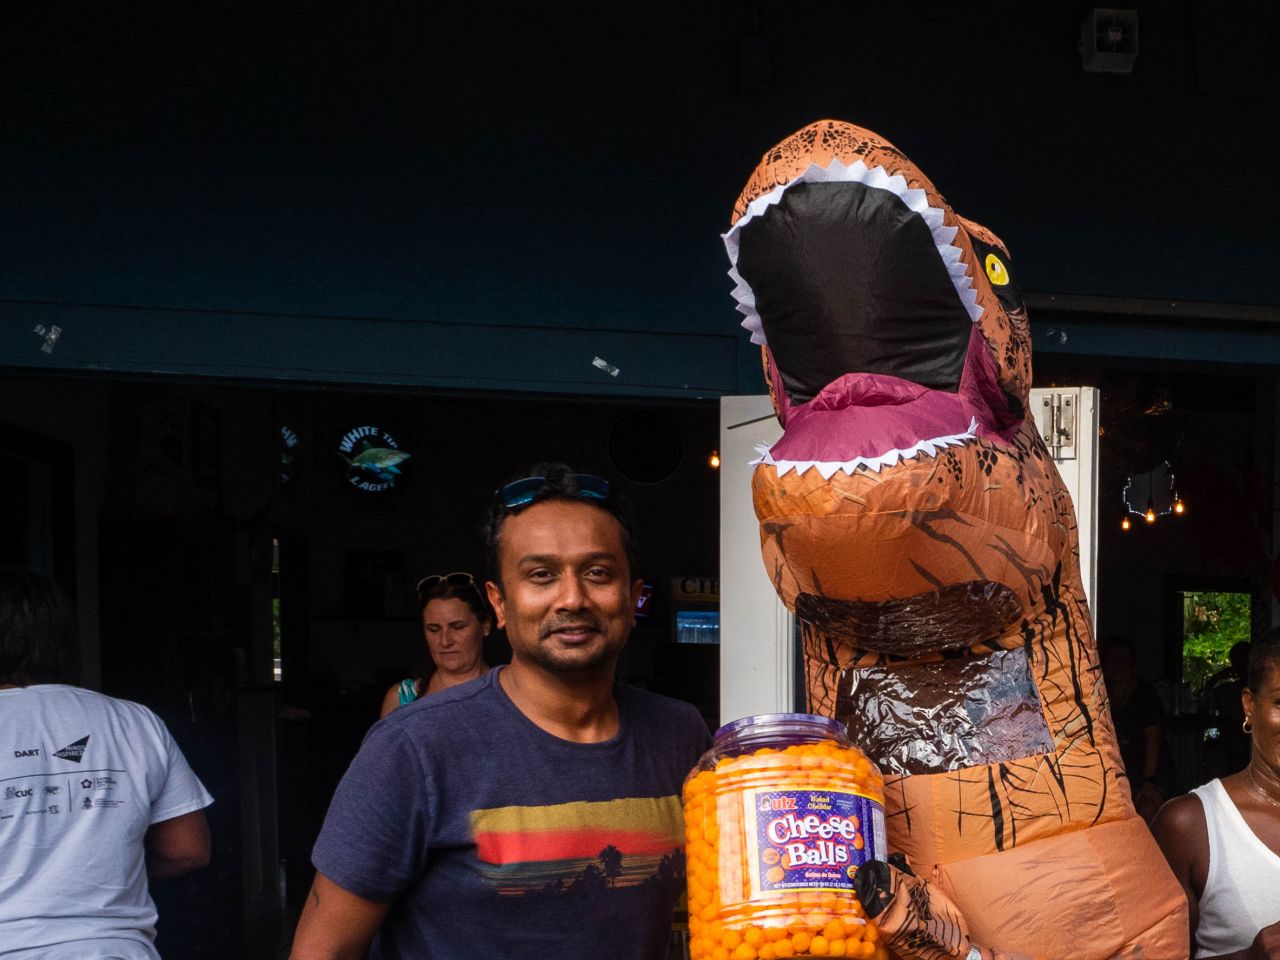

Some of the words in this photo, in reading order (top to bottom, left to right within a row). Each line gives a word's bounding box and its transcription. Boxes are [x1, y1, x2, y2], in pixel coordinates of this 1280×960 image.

[339, 426, 378, 453] WHITE
[14, 749, 40, 758] DART
[14, 788, 33, 798] CUC
[768, 814, 856, 844] Cheese
[786, 841, 848, 867] Balls
